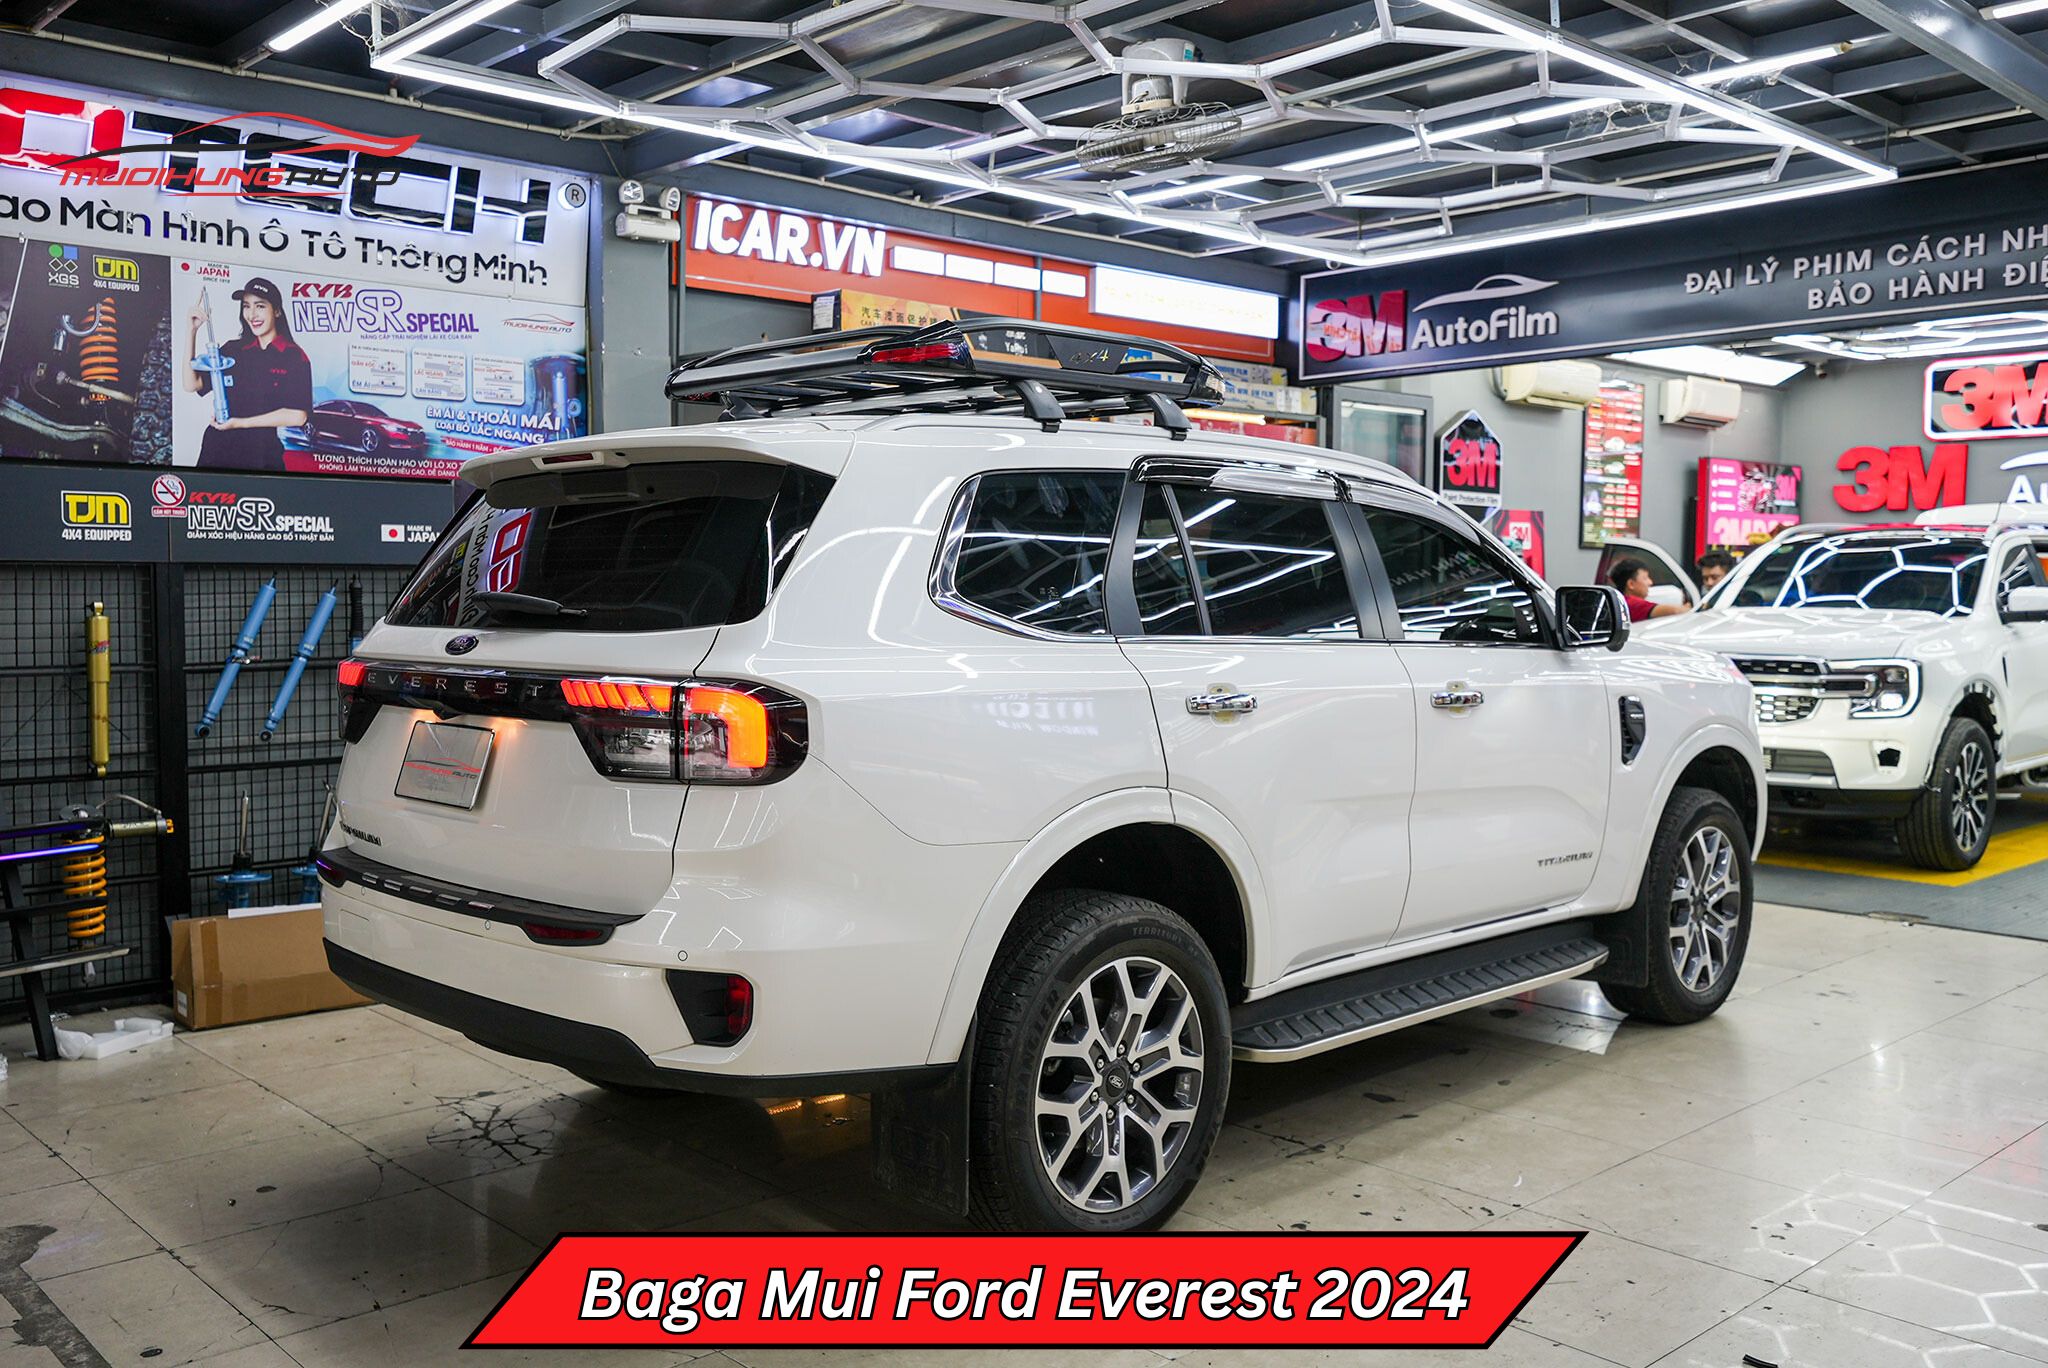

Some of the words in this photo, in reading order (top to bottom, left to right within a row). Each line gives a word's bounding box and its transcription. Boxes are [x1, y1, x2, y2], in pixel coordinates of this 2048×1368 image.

[60, 196, 151, 237] Màn
[162, 210, 249, 248] Hình
[259, 218, 289, 252] Ô
[301, 229, 347, 260] Tô
[355, 236, 467, 283] Thông
[474, 252, 548, 285] Minh
[693, 199, 886, 278] ICAR.VN
[48, 272, 80, 285] XGS
[95, 257, 137, 281] TJM
[196, 266, 230, 278] JAPAN
[1684, 266, 1734, 295] ĐẠI
[1745, 255, 1780, 286] LÝ
[1793, 249, 1873, 280] PHIM
[1886, 234, 1986, 267] CÁCH
[108, 281, 140, 292] EQUIPPED
[1808, 280, 1874, 310] BẢO
[1888, 269, 1985, 300] HÀNH
[292, 300, 355, 333] NEW
[406, 312, 480, 333] SPECIAL
[1306, 288, 1409, 362] 3M
[1411, 304, 1559, 350] AutoFilm
[521, 412, 561, 431] MÁI
[494, 429, 545, 444] NGANG
[360, 465, 377, 473] THAY
[1447, 438, 1498, 488] 3M
[1833, 444, 1969, 512] 3M
[64, 493, 129, 525] TJM
[187, 505, 237, 531] NEW
[275, 515, 334, 533] SPECIAL
[84, 529, 132, 542] EQUIPPED
[266, 533, 282, 541] CAO
[366, 671, 543, 698] EVEREST
